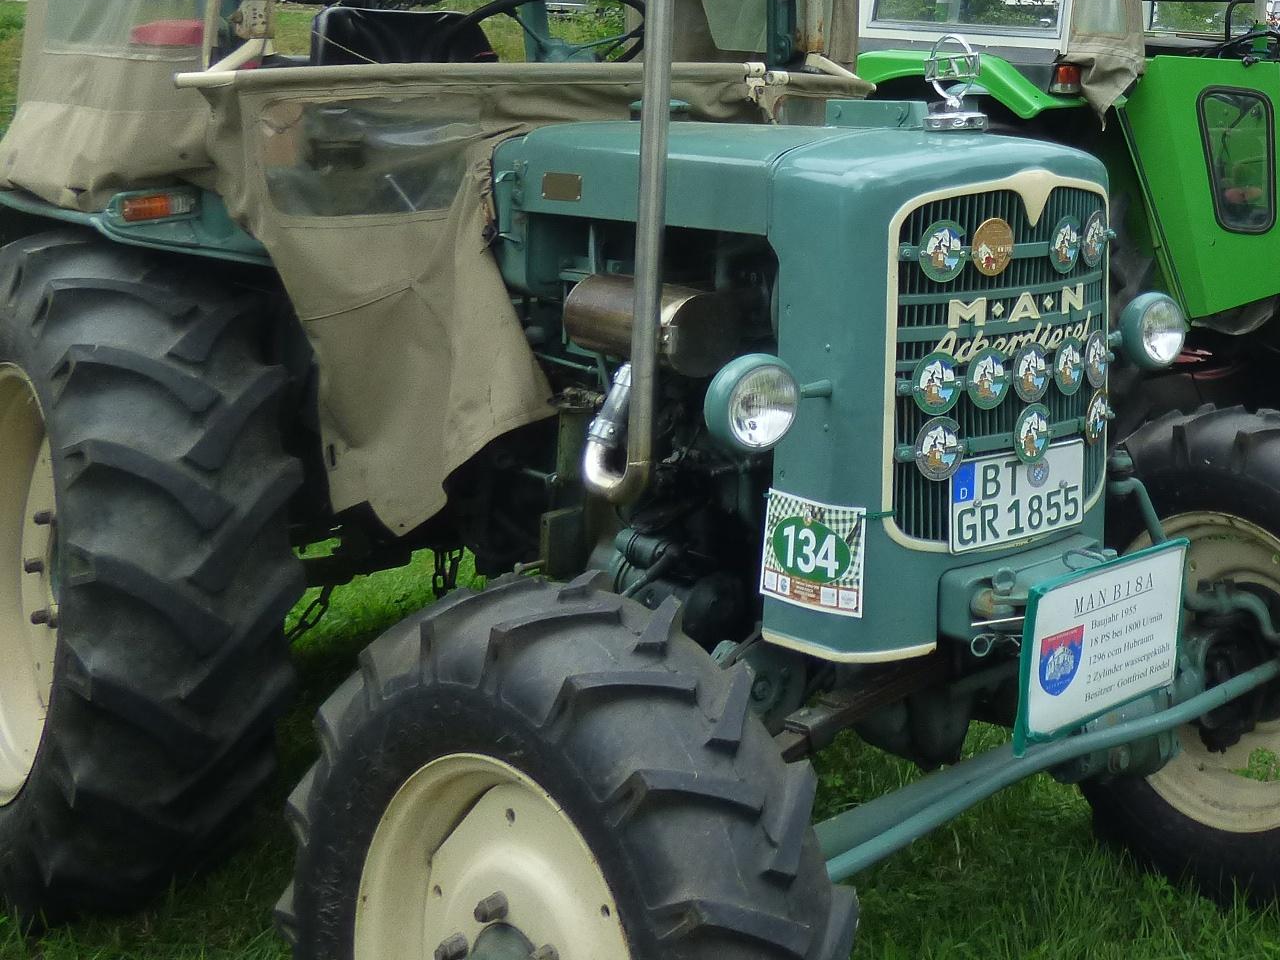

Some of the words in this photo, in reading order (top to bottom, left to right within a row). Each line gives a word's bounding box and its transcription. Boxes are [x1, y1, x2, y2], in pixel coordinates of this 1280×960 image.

[932, 310, 1092, 364] Ackerdiesel
[960, 487, 968, 500] D
[982, 460, 1024, 501] BT
[957, 503, 1001, 546] GR
[1006, 485, 1079, 537] 1855
[783, 525, 839, 578] 134
[1074, 589, 1107, 615] MAN
[1113, 572, 1153, 601] B18A
[1089, 633, 1099, 648] 18
[1100, 630, 1111, 644] PS
[1111, 625, 1123, 640] bei
[1124, 619, 1141, 637] 1800
[1091, 612, 1120, 630] Baujahr
[1120, 604, 1137, 622] 1955
[1088, 649, 1106, 666] 1296
[1107, 645, 1122, 660] ccm
[1123, 634, 1154, 656] Hubraum
[1093, 660, 1123, 682] Zylinder
[1124, 643, 1170, 669] wassergekühlt
[1117, 668, 1148, 689] Gottfried
[1149, 659, 1170, 676] Riedel
